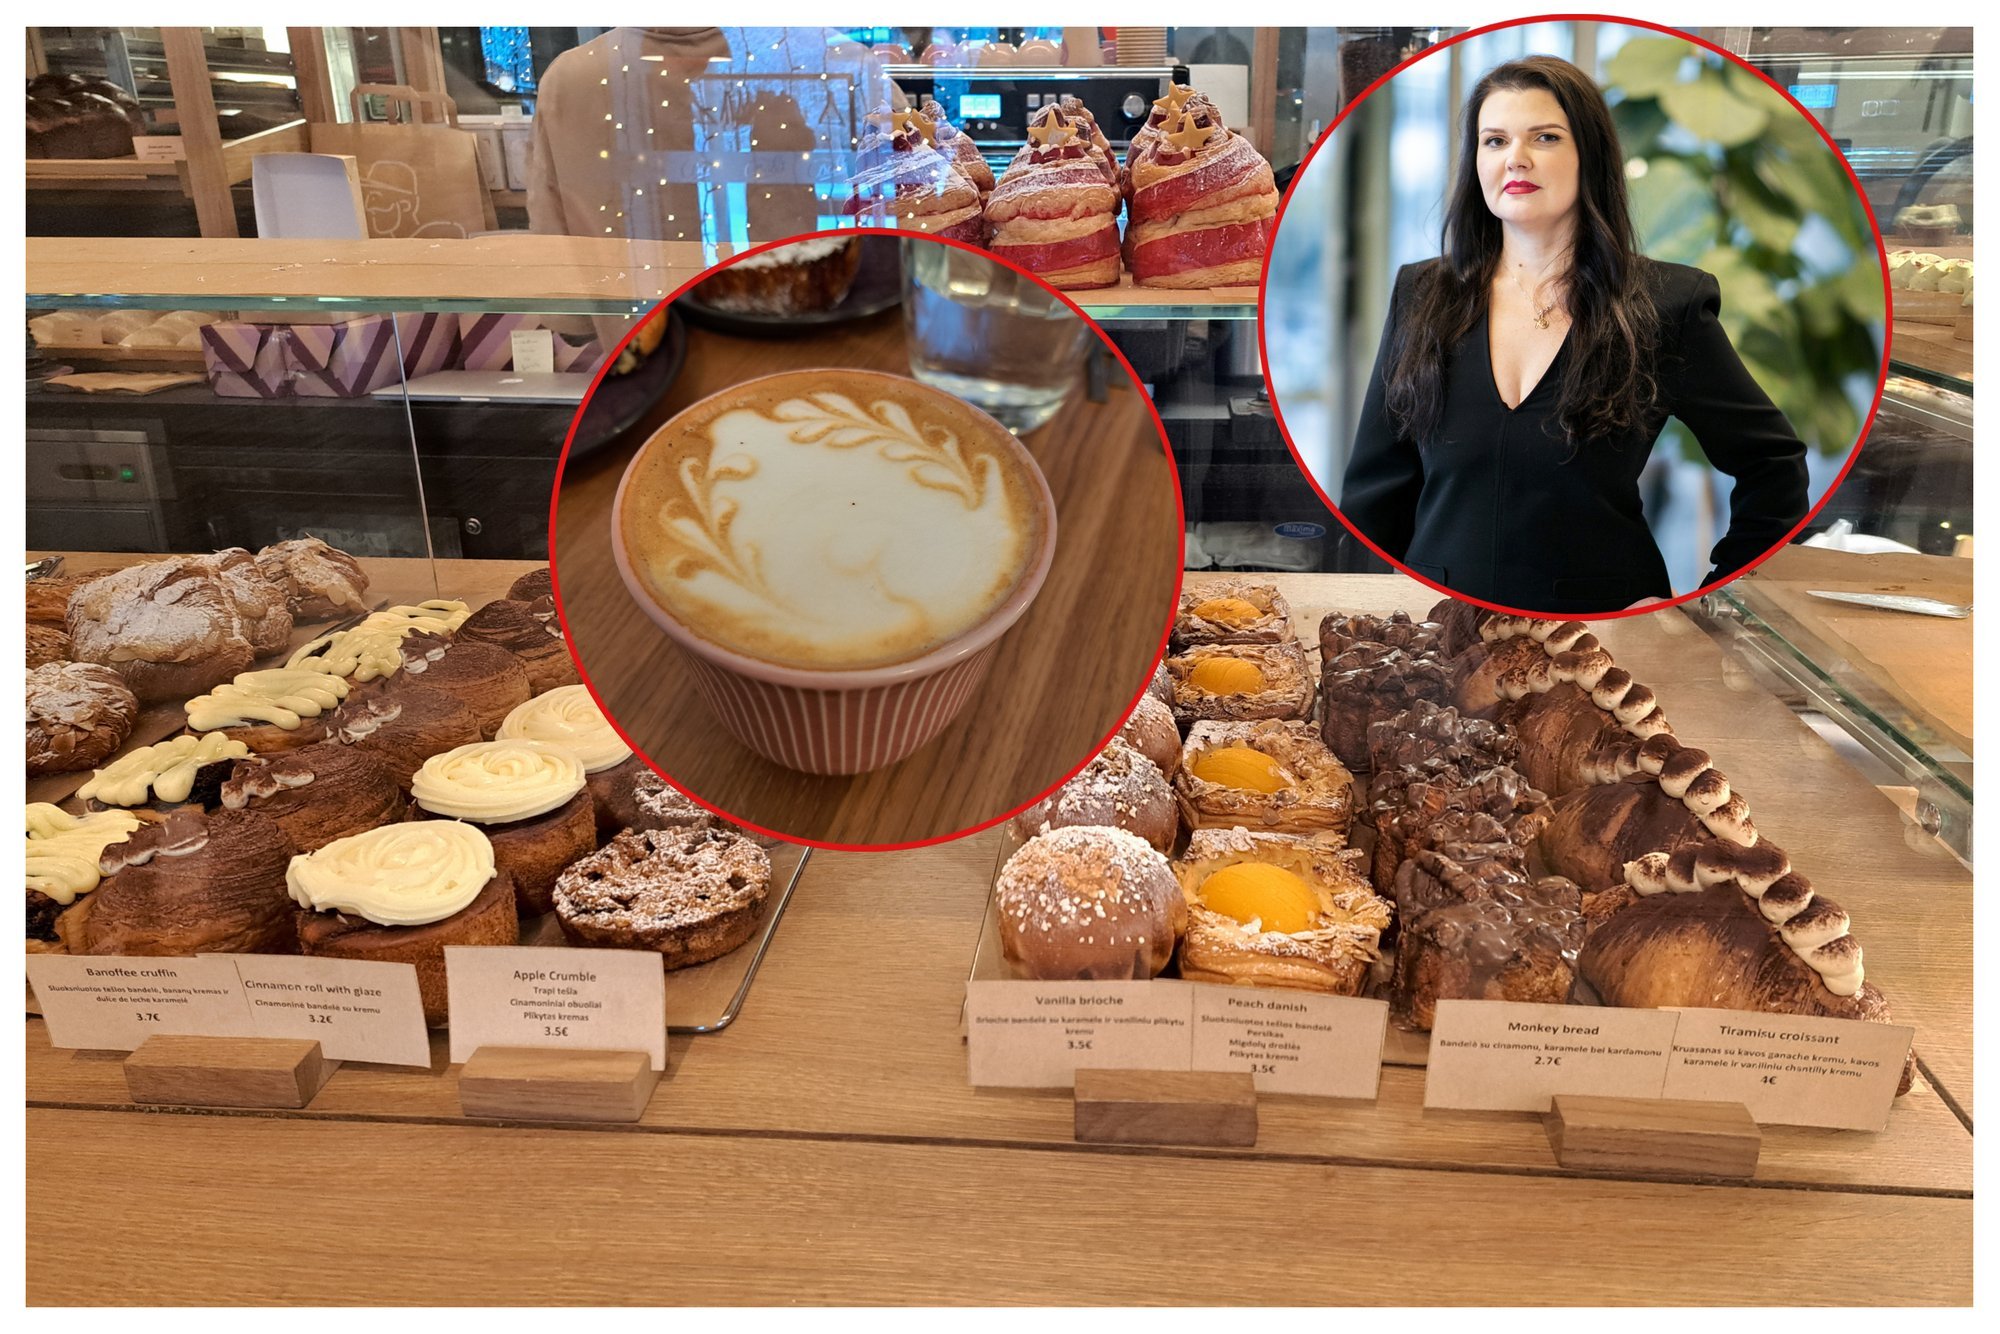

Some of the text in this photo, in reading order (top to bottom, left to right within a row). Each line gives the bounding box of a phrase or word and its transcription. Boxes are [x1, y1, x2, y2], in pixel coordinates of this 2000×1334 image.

[86, 968, 177, 977] Banoffee cruffin
[514, 971, 596, 982] Apple Crumble
[245, 980, 381, 997] Cinnamon roll with glaze
[533, 987, 577, 996] Trapi tešla
[510, 999, 601, 1008] Cinamoniniai obuoliai
[1036, 997, 1123, 1005] Vanilla brioche
[1228, 998, 1307, 1013] Peach danish
[354, 1006, 380, 1014] kremu
[136, 1013, 160, 1022] 3.7€
[309, 1015, 333, 1024] 3.2€
[524, 1012, 589, 1021] Plikytas kremas
[545, 1027, 568, 1036] 3.5€
[1508, 1022, 1599, 1035] Monkey bread
[1720, 1026, 1839, 1044] Tiramisu croissant
[1068, 1041, 1093, 1049] 3.5€
[1607, 1048, 1661, 1056] kardamonu
[1673, 1045, 1722, 1054] Kruasanas
[1738, 1048, 1765, 1057] kavos
[1768, 1051, 1810, 1061] ganache
[1812, 1054, 1847, 1065] kremu,
[1850, 1057, 1879, 1068] kavos
[1535, 1056, 1561, 1065] 2.7€
[1250, 1064, 1275, 1074] 3.5€
[1684, 1058, 1728, 1067] karamele
[1731, 1060, 1739, 1068] ir
[1830, 1067, 1862, 1077] kremu
[1760, 1075, 1777, 1085] 4€
